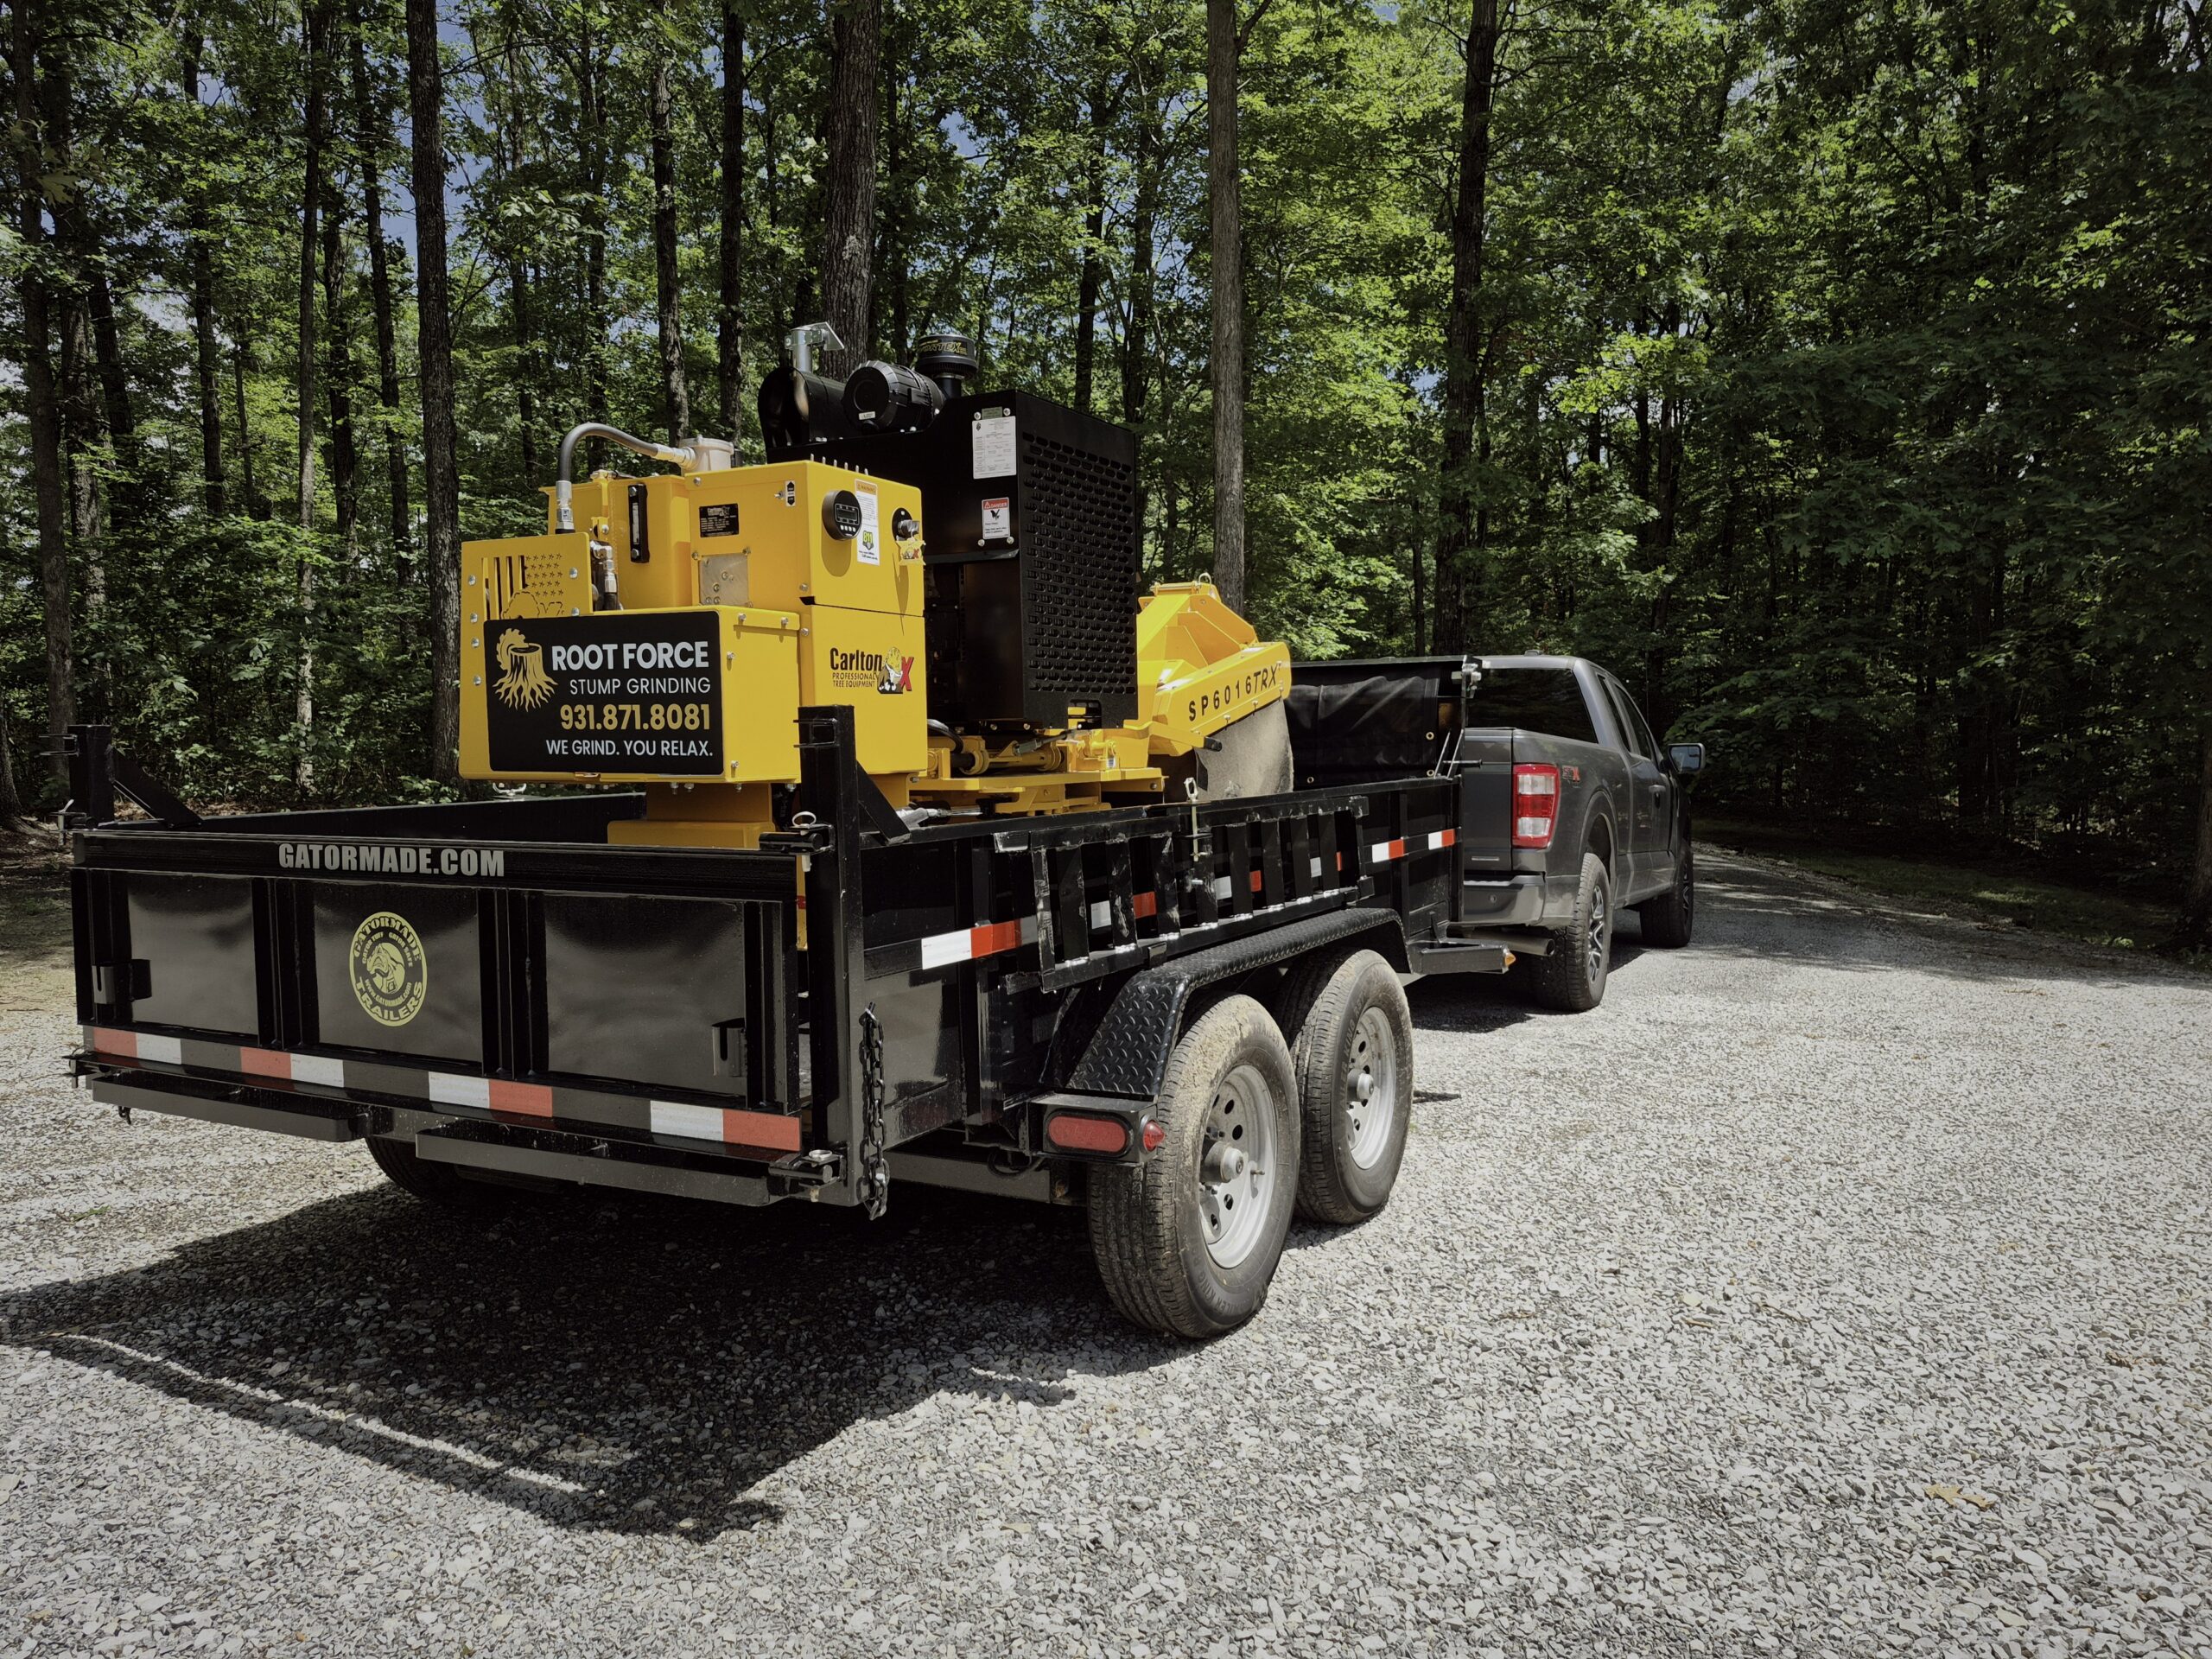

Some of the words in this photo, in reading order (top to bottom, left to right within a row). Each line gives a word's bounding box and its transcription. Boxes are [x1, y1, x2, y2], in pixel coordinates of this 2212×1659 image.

[863, 530, 874, 543] 811
[551, 644, 618, 671] ROOT
[622, 641, 709, 669] FORCE
[830, 647, 883, 671] Carlton
[569, 678, 621, 695] STUMP
[626, 677, 711, 695] GRINDING
[832, 671, 877, 681] PROFESSIONAL
[1188, 664, 1279, 722] SP6016TRX
[560, 703, 710, 730] 931.871.8081
[546, 740, 569, 755] WE
[571, 740, 620, 756] GRIND.
[623, 740, 657, 756] YOU
[660, 740, 714, 756] RELAX.
[278, 842, 505, 877] GATORMADE.COM
[353, 916, 422, 962] GATORMADE
[362, 939, 373, 964] GATOR
[388, 931, 406, 949] GATOR
[404, 946, 414, 968] SAFE
[355, 976, 423, 1020] TRAILERS
[1344, 1018, 1357, 1058] KING
